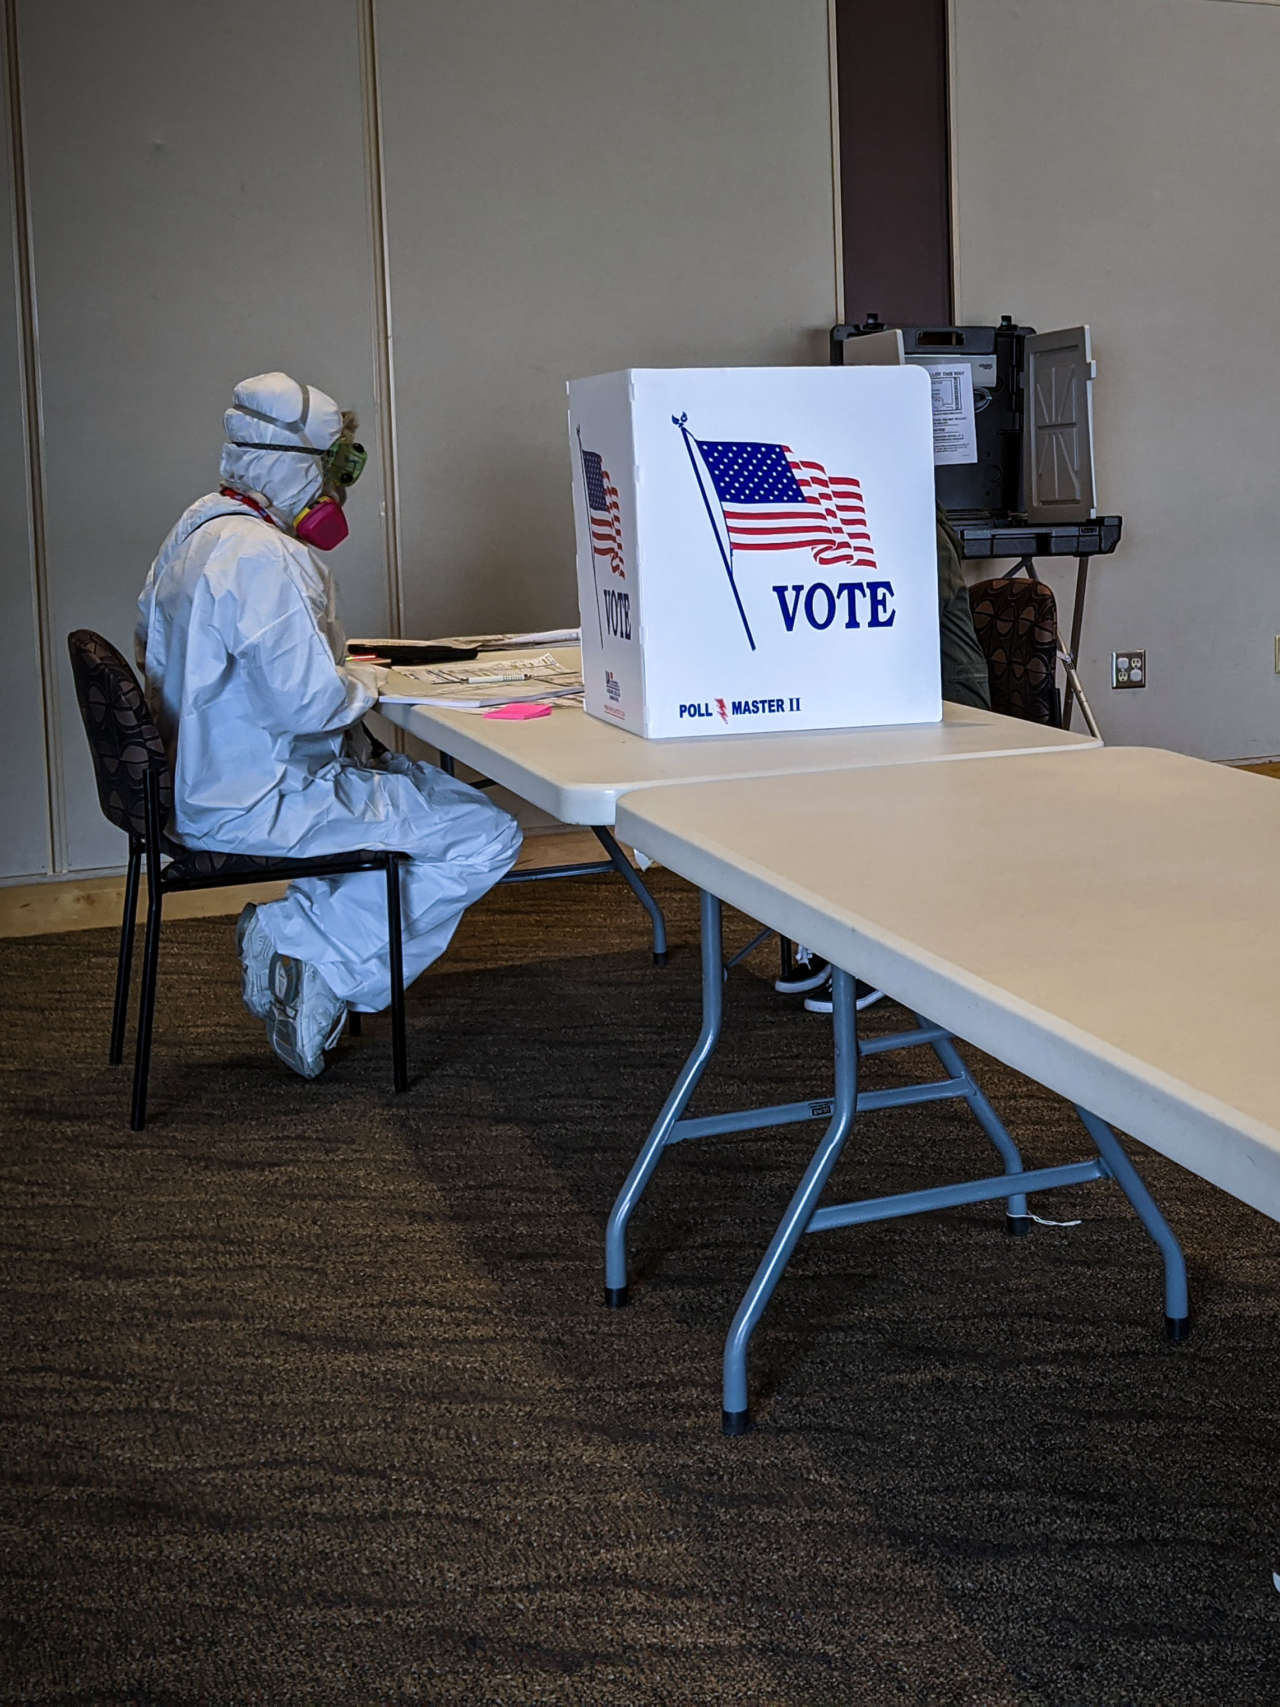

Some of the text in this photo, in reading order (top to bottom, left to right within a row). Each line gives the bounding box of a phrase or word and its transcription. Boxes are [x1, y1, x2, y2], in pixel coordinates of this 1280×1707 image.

[603, 589, 632, 641] VOTE
[772, 581, 896, 632] VOTE
[679, 697, 801, 718] POLL MASTER II
